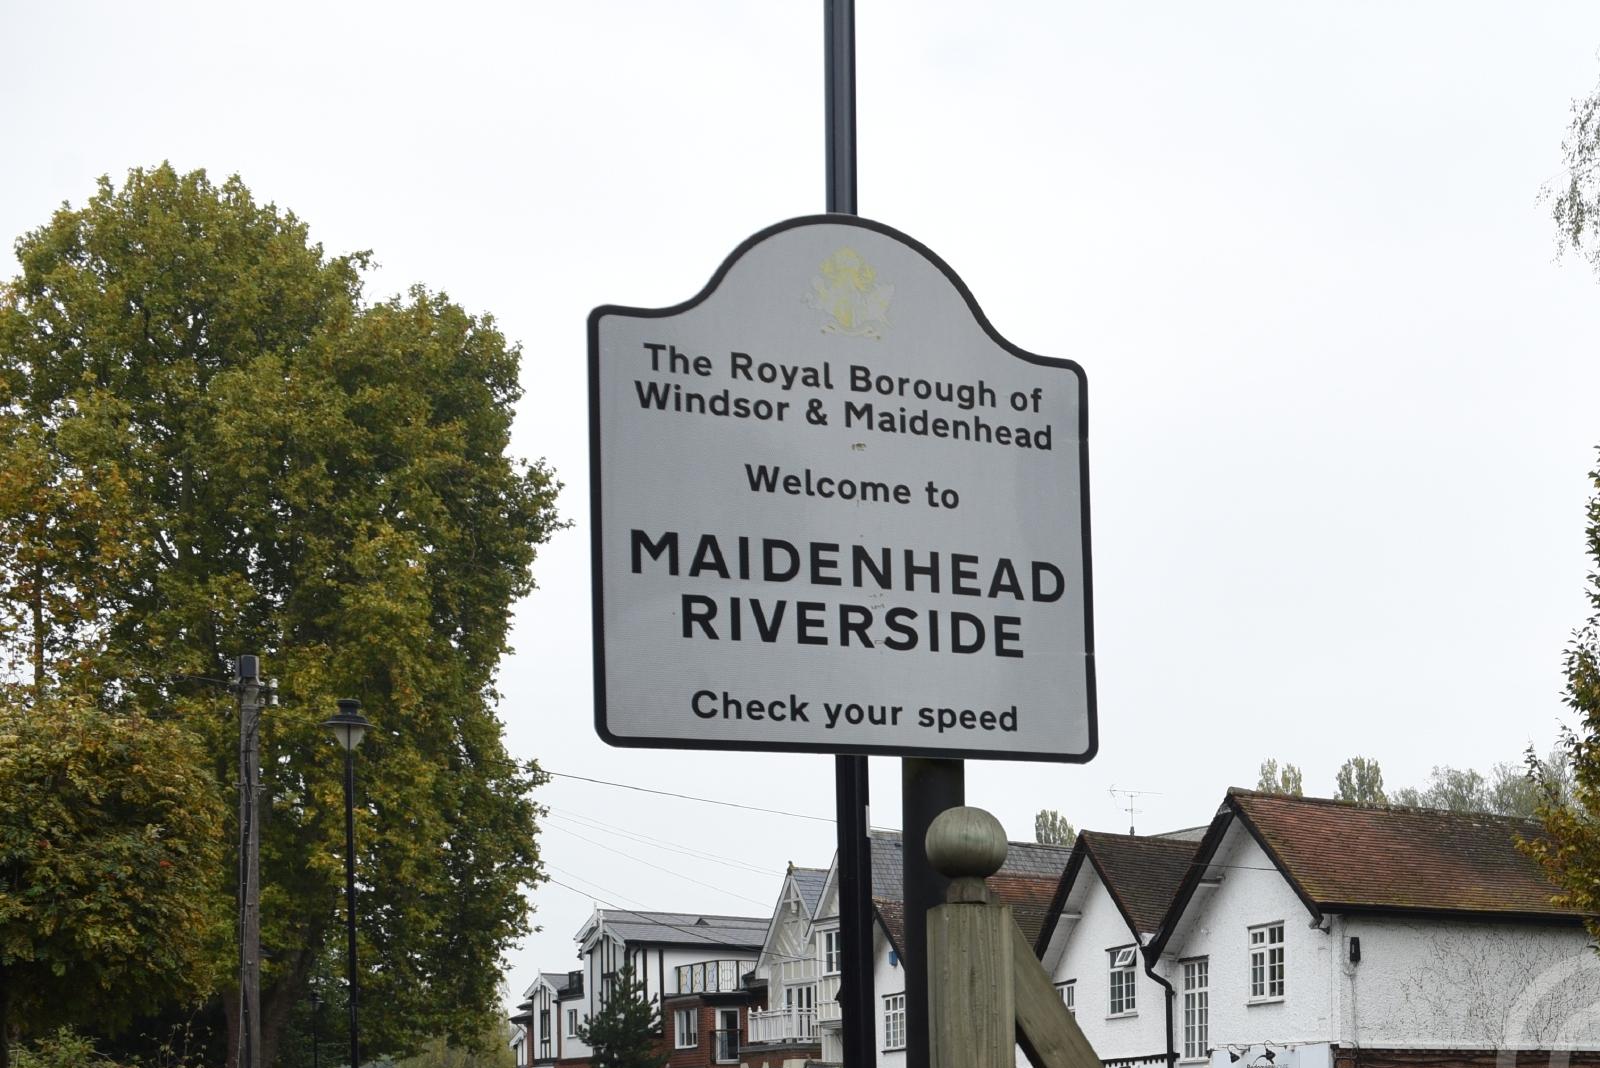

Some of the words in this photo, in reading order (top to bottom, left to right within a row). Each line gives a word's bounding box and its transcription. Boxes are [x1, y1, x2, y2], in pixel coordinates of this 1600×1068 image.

[643, 342, 713, 377] The
[730, 351, 834, 391] Royal
[849, 364, 997, 410] Borough
[1010, 387, 1043, 414] of
[633, 379, 790, 422] Windsor
[805, 398, 828, 426] &
[844, 401, 1052, 451] Maidenhead
[744, 463, 911, 505] Welcome
[924, 481, 960, 510] to
[630, 528, 1066, 603] MAIDENHEAD
[681, 593, 1025, 659] RIVERSIDE
[691, 689, 810, 723] Check
[823, 702, 903, 730] your
[918, 705, 1018, 734] speed
